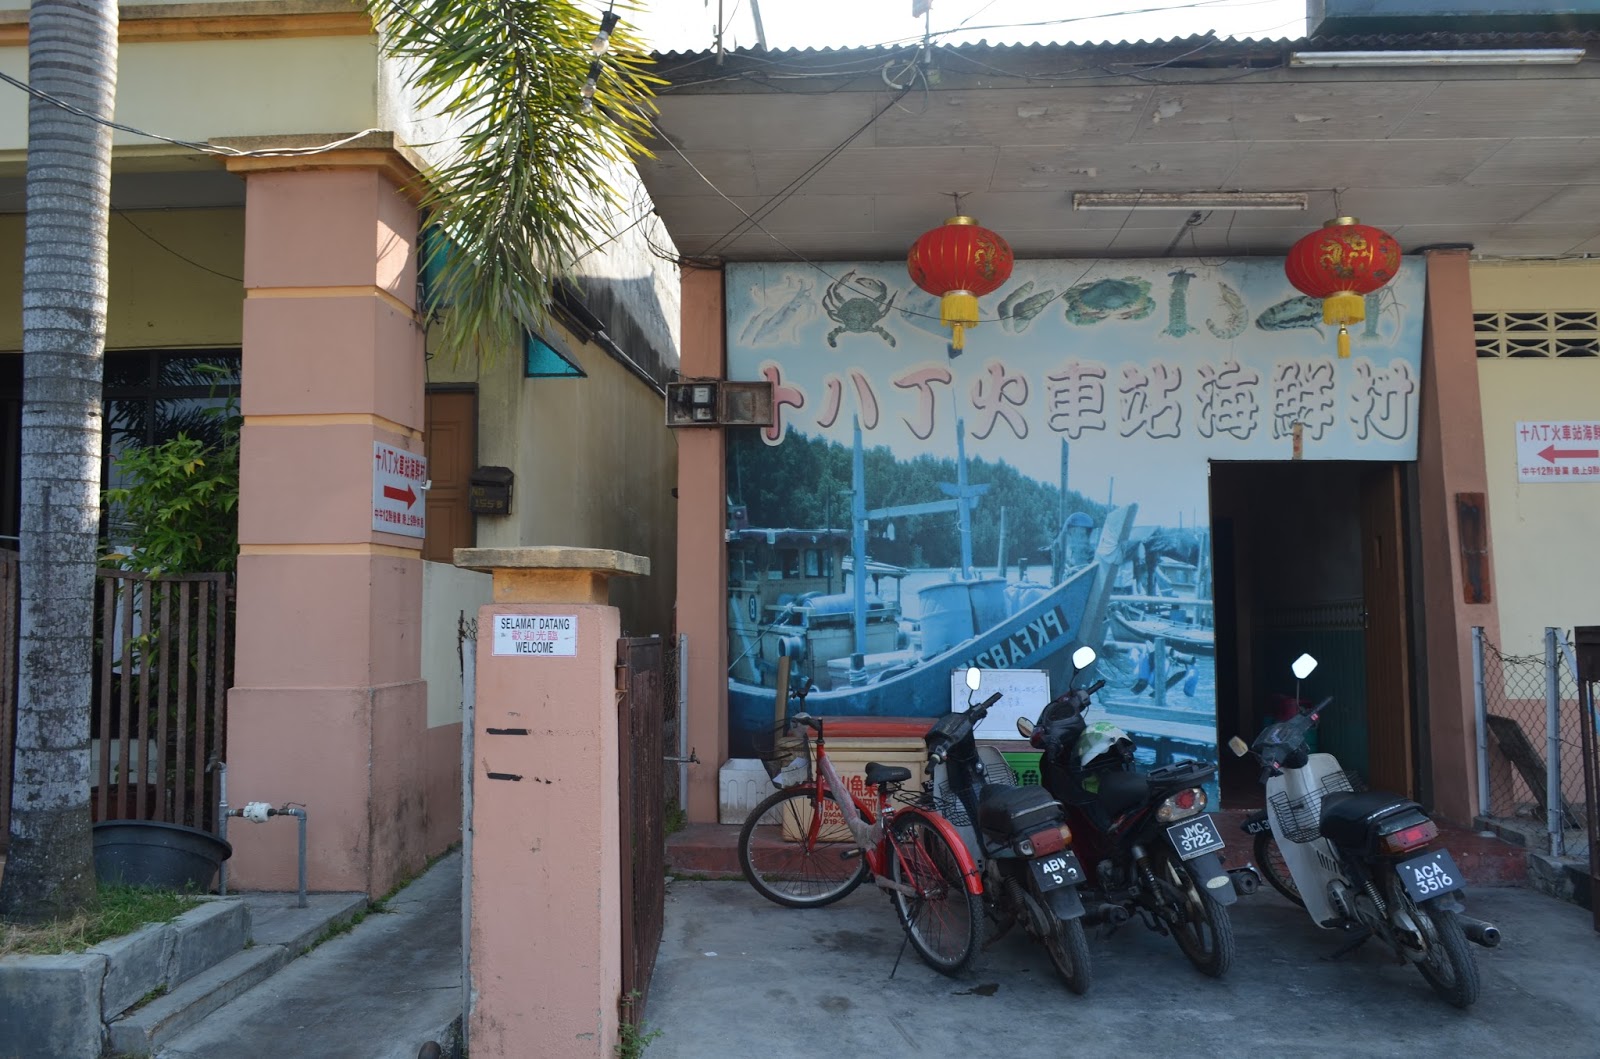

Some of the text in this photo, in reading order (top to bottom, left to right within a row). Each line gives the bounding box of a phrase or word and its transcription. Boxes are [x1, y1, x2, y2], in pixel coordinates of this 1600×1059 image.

[501, 618, 570, 630] SELAMAT DATANG
[511, 630, 559, 641] 歡迎光臨
[515, 641, 554, 654] WELCOME
[1181, 822, 1205, 840] JMC
[1181, 832, 1214, 851] 3722
[1414, 862, 1443, 882] ACA
[1416, 873, 1453, 894] 3516
